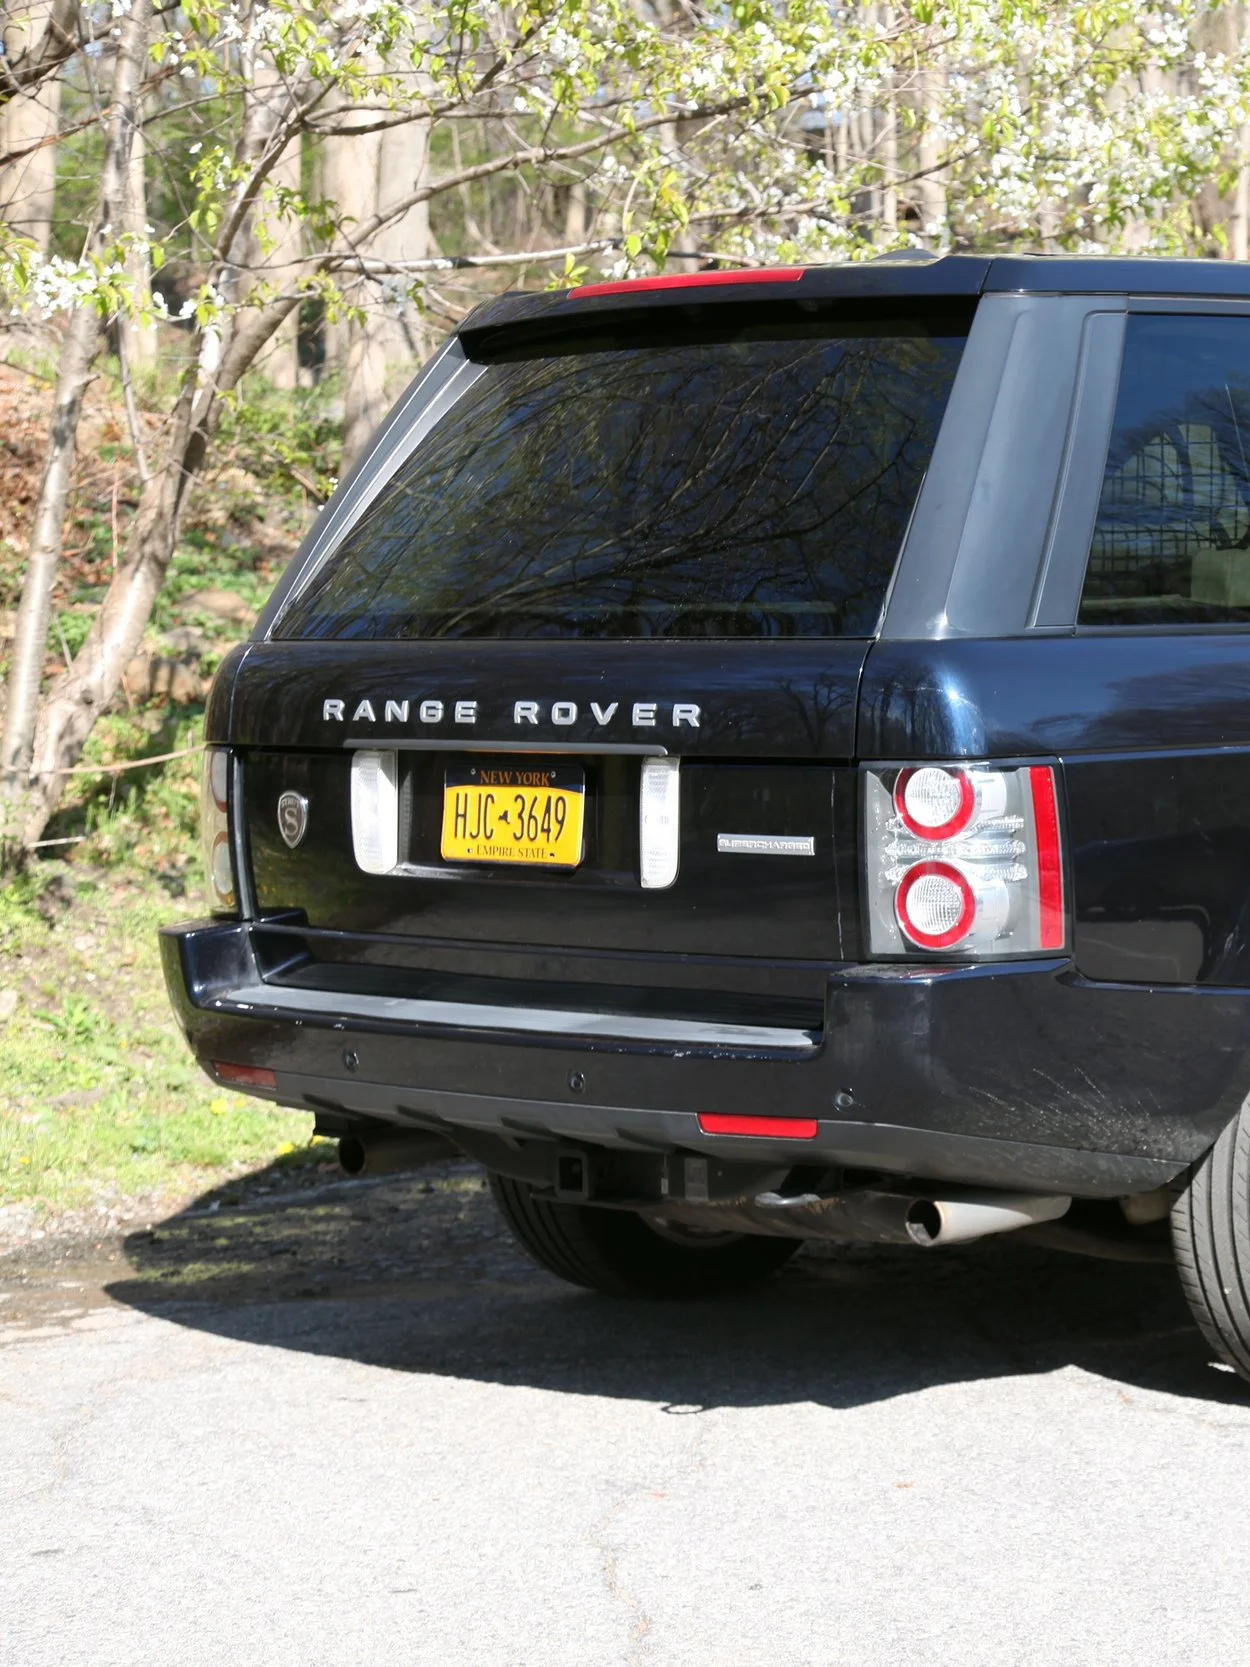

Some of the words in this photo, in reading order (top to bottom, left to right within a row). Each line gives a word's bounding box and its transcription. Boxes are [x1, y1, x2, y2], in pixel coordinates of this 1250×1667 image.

[322, 699, 478, 723] RANGE
[514, 701, 701, 727] ROVER
[480, 770, 512, 784] NEW
[515, 771, 549, 786] YORK
[454, 792, 494, 840] HJC
[513, 794, 566, 843] 3649
[476, 844, 514, 857] EMPIRE
[518, 848, 547, 859] STATE
